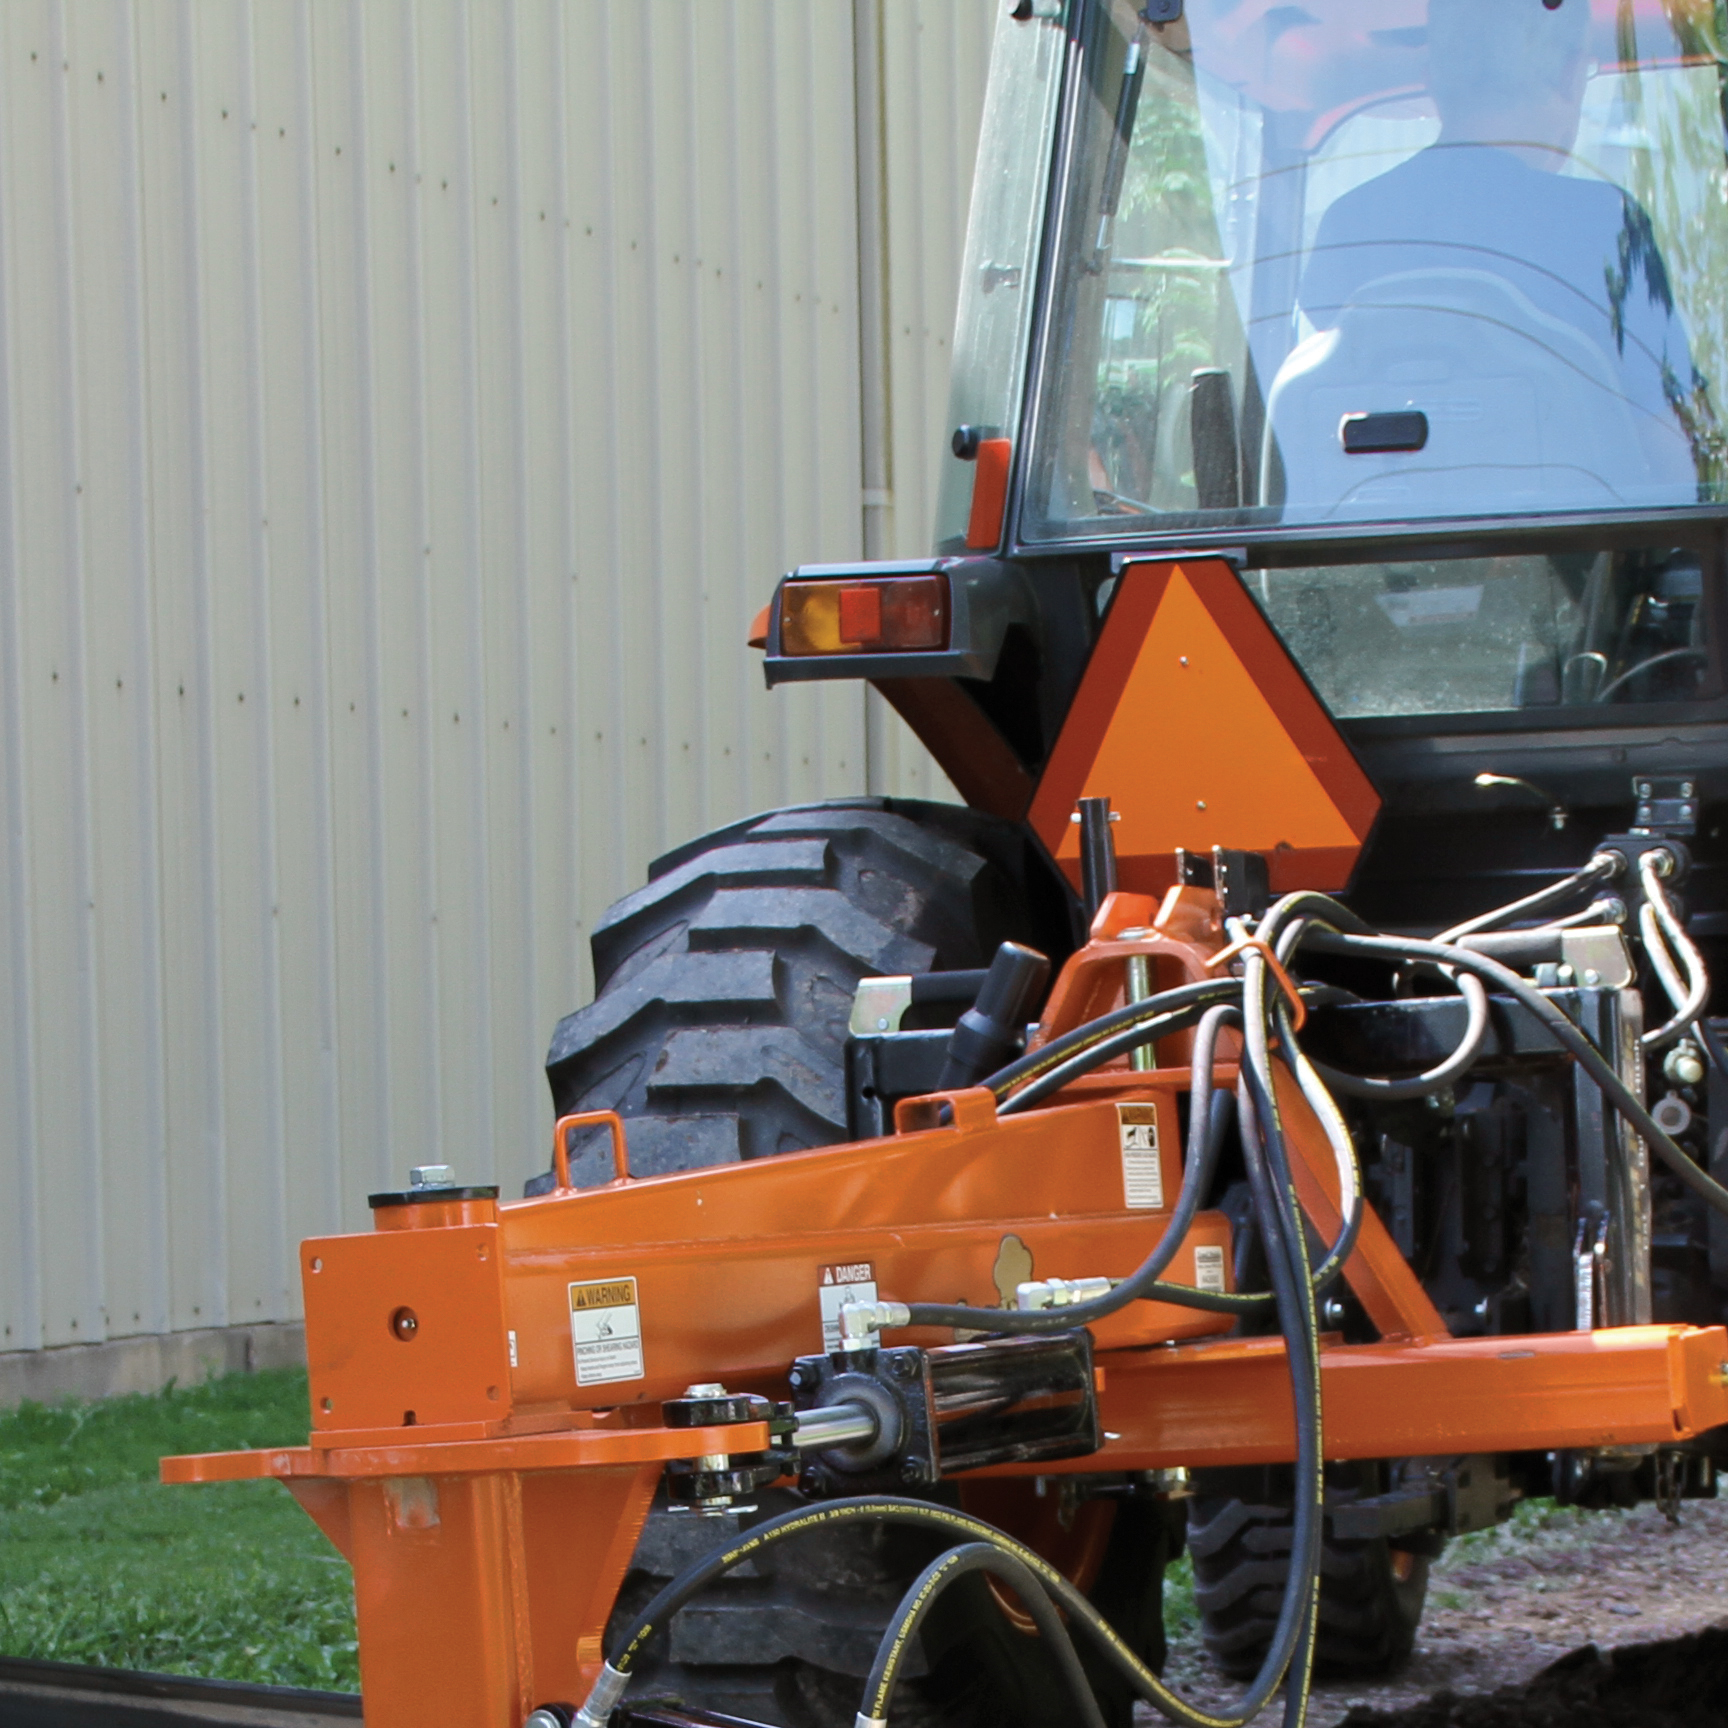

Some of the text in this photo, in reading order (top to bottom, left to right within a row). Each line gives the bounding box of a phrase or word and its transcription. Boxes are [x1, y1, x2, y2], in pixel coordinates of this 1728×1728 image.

[836, 1264, 872, 1283] DANGER
[586, 1284, 631, 1306] WARNING
[874, 1681, 889, 1710] FLAME
